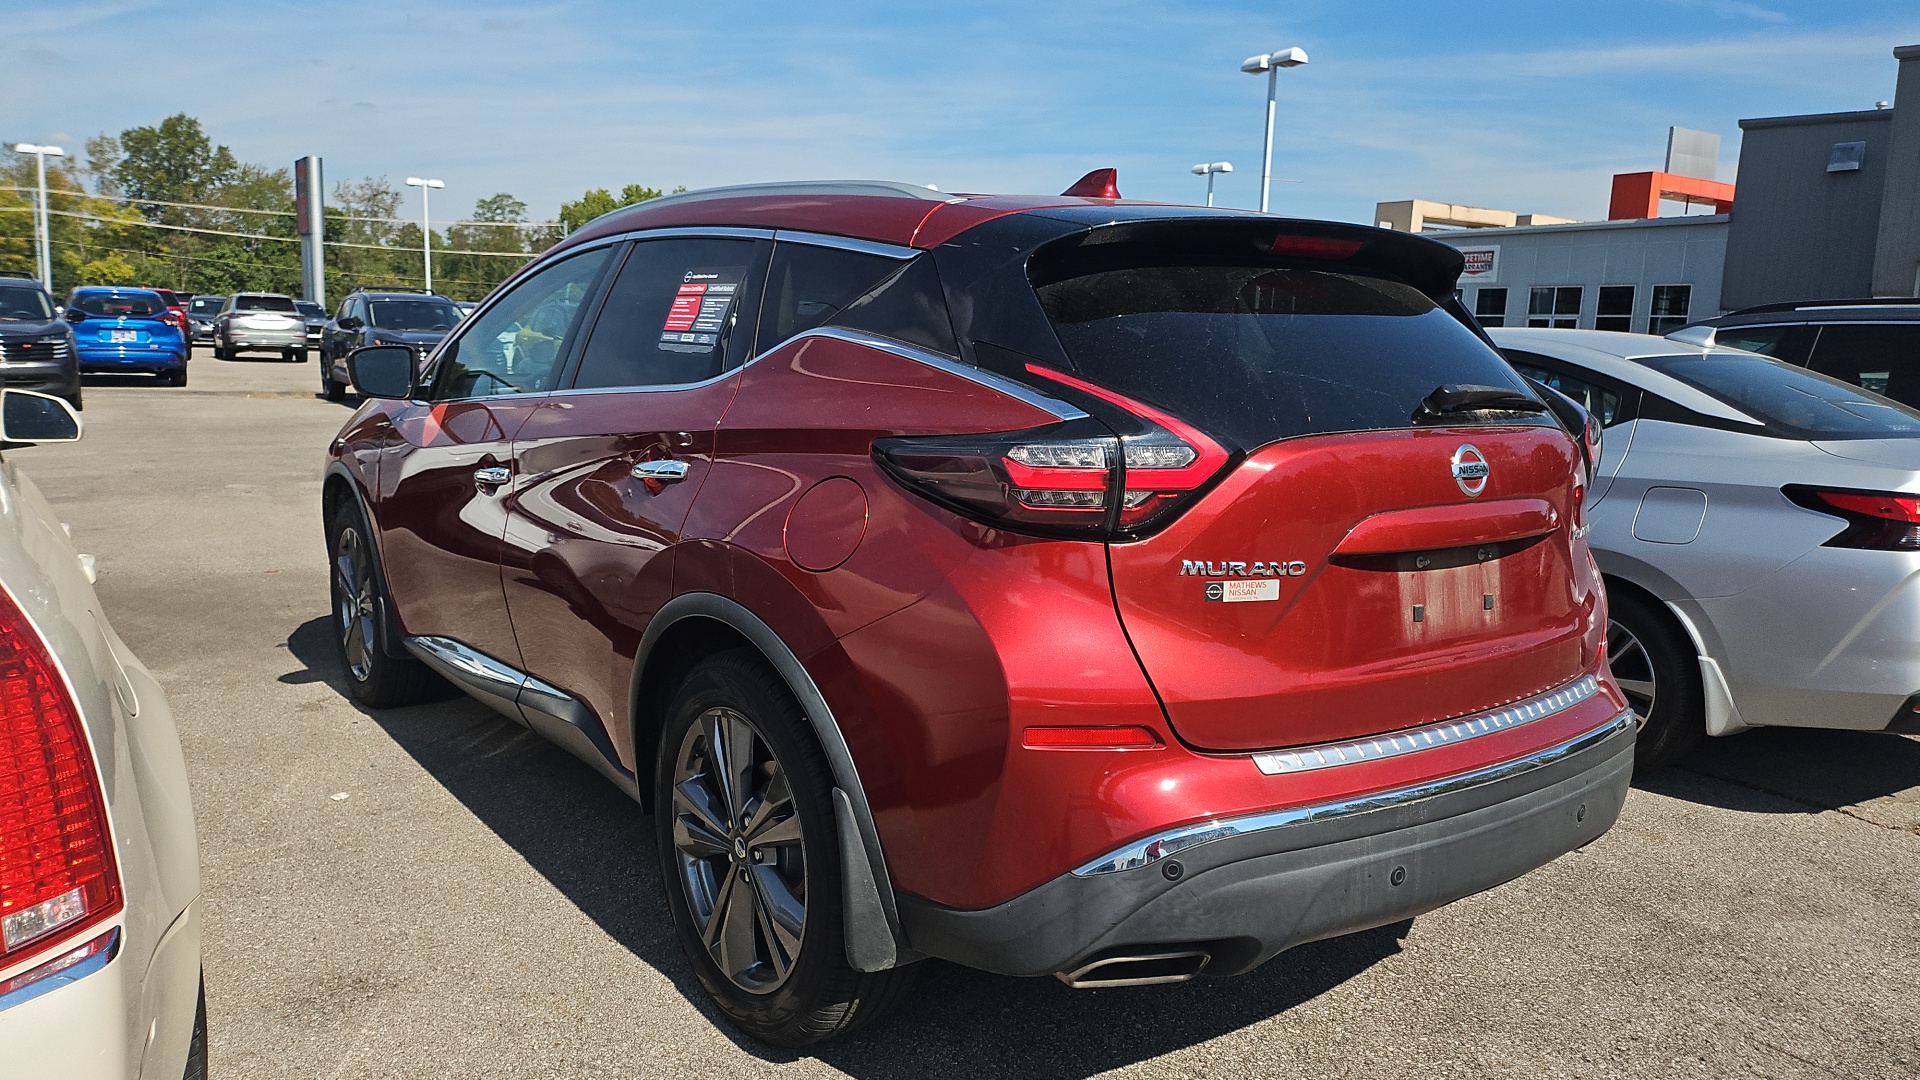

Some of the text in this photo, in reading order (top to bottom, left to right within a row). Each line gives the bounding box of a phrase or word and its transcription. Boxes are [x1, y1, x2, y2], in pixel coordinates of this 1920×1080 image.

[1464, 253, 1493, 262] FETIME
[1459, 465, 1488, 474] NISSAN
[1180, 560, 1306, 577] MURANO
